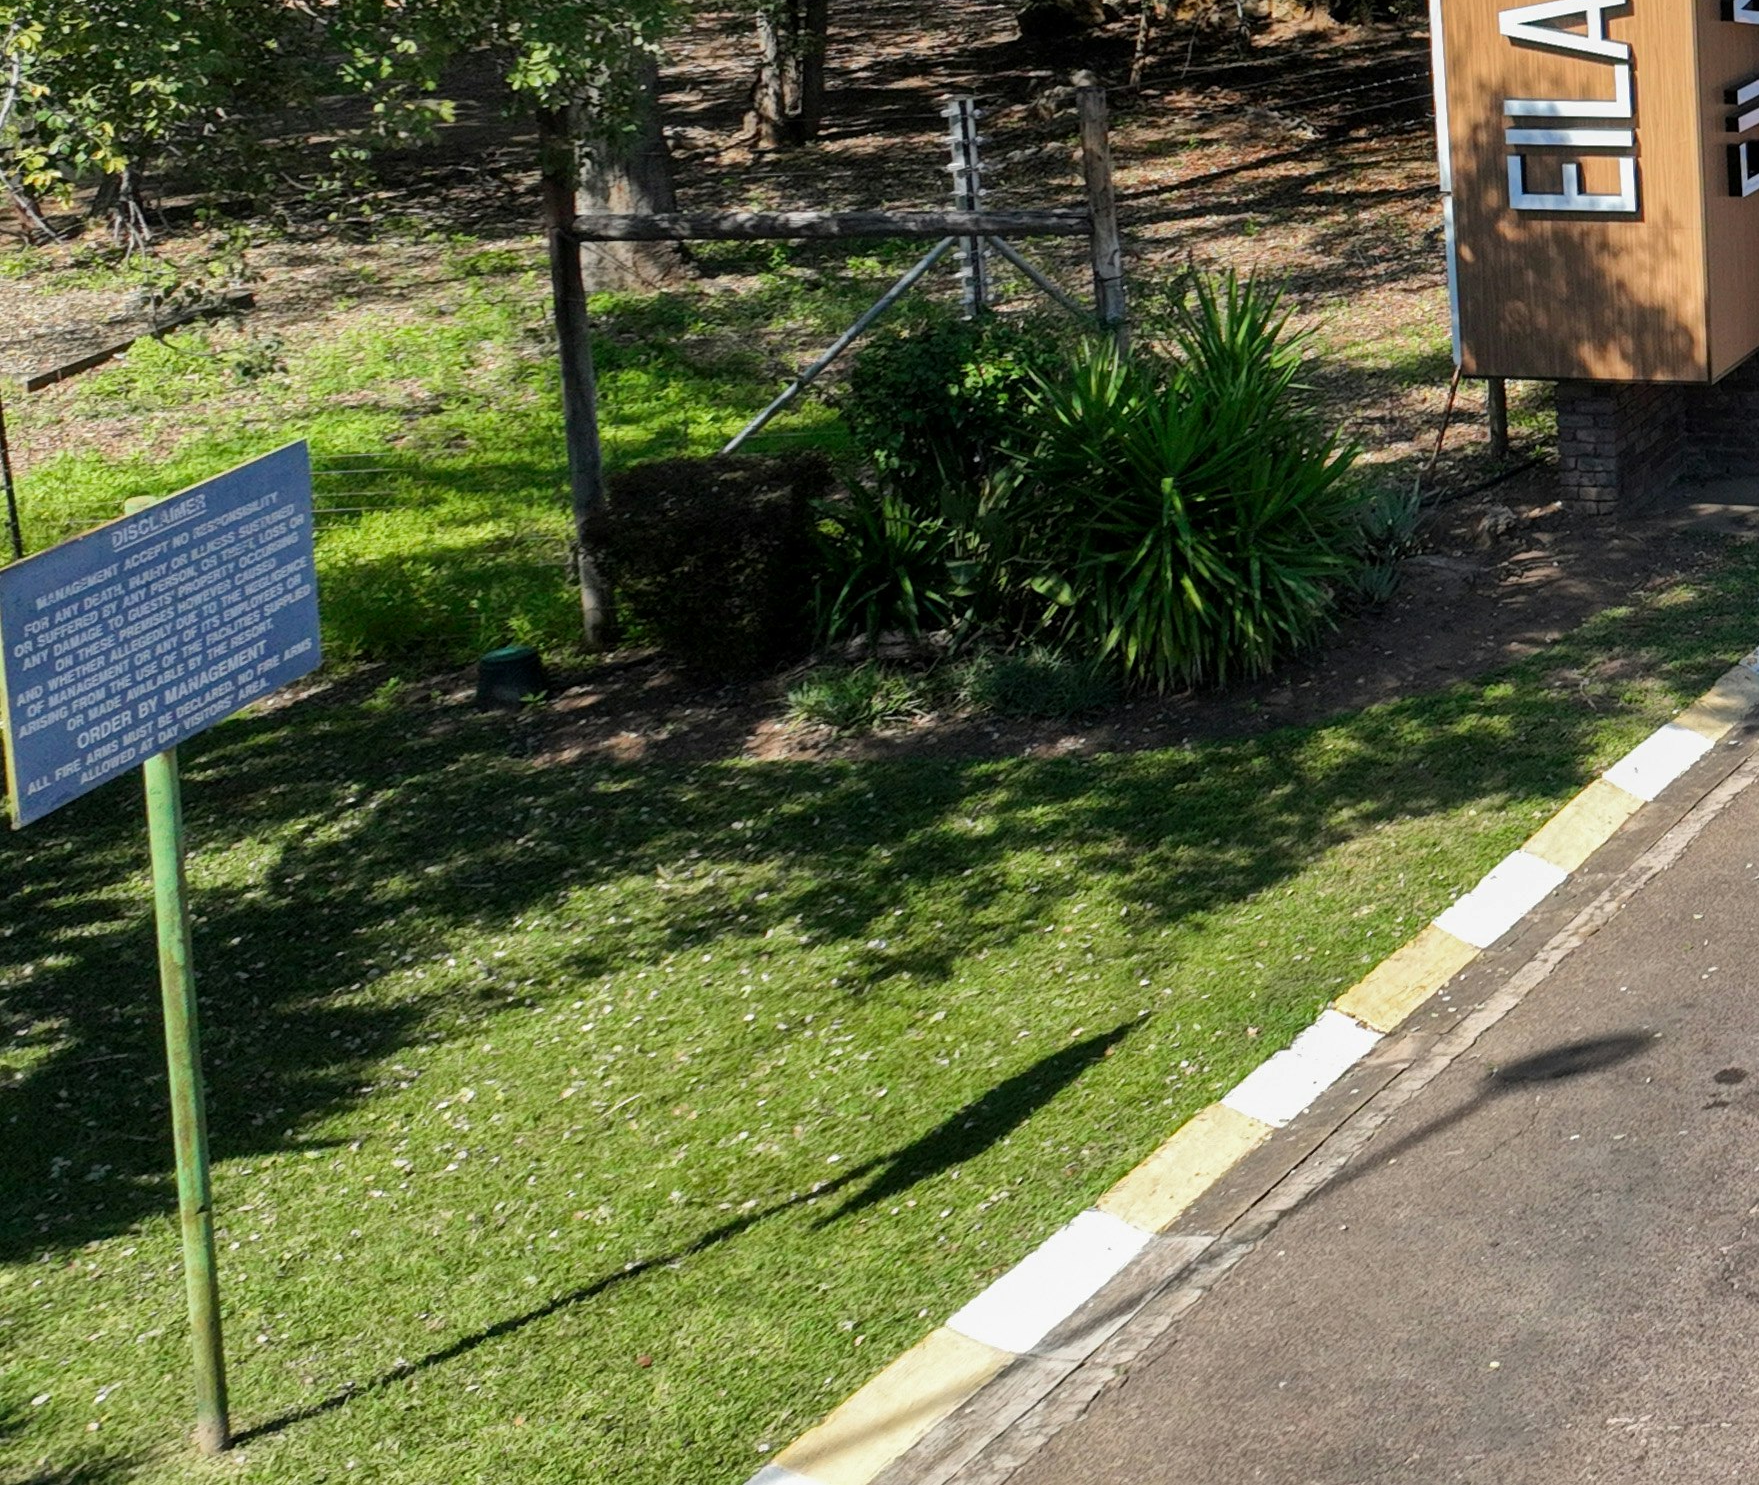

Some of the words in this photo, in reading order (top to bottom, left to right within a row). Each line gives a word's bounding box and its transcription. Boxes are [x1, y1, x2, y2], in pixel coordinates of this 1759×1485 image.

[13, 640, 32, 658] OR
[36, 610, 98, 648] SUFFERED
[101, 601, 117, 618] BY
[122, 587, 146, 608] ANY
[150, 564, 197, 597] PERSON,
[200, 554, 217, 572] OR
[258, 521, 286, 544] LOSS
[289, 513, 304, 529] OR
[23, 616, 49, 637] FOR
[54, 602, 79, 623] ANY
[83, 582, 124, 611] DEATH,
[128, 562, 168, 589] INJURY
[170, 553, 187, 570] OR
[191, 531, 234, 560] ILLNESS
[238, 503, 294, 538] SUSTAINED
[35, 563, 119, 610] MANAGEMENT
[123, 541, 168, 571] ACCEPT
[172, 532, 189, 548] NO
[192, 492, 278, 539] RESPONSIBILITY
[111, 493, 206, 548] DISCLAIMER
[16, 684, 43, 707] AND
[47, 655, 104, 691] WHETHER
[109, 623, 172, 662] ALLEGEDLY
[176, 610, 198, 630] DUE
[202, 601, 216, 617] TO
[220, 589, 241, 607] THE
[244, 556, 307, 595] NEGLIGENCE
[18, 705, 67, 739] ARISING
[71, 687, 105, 712] FROM
[109, 674, 131, 694] THE
[135, 661, 157, 681] USE
[161, 651, 177, 668] OF
[181, 639, 202, 658] THE
[205, 610, 260, 645] FACILITIES
[263, 583, 310, 616] SUPPLIED
[22, 649, 48, 671] ANY
[53, 624, 103, 656] DAMAGE
[108, 614, 123, 631] TO
[177, 562, 234, 597] PROPERTY
[238, 531, 298, 568] OCCURRING
[26, 700, 44, 718] OF
[48, 659, 129, 707] MANAGEMENT
[133, 649, 150, 666] OR
[154, 636, 178, 655] ANY
[182, 626, 197, 642] OF
[201, 615, 219, 632] ITS
[223, 583, 283, 622] EMPLOYEES
[286, 573, 301, 589] OR
[55, 654, 73, 672] ON
[76, 634, 115, 662] THESE
[118, 606, 174, 641] PREMISES
[177, 578, 231, 613] HOWEVER
[234, 557, 275, 586] CAUSED
[27, 774, 50, 795] ALL
[54, 758, 81, 781] FIRE
[85, 739, 118, 765] ARMS
[122, 721, 153, 746] MUST
[157, 711, 173, 728] BE
[237, 668, 253, 685] NO
[257, 654, 280, 675] FIRE
[283, 637, 312, 660] ARMS
[66, 713, 84, 731] OR
[88, 695, 121, 721] MADE
[125, 663, 184, 701] AVAILABLE
[188, 654, 202, 670] BY
[206, 641, 227, 660] THE
[77, 710, 132, 749] ORDER
[137, 696, 158, 718] BY
[164, 639, 267, 705] MANAGEMENT
[80, 746, 135, 784] ALLOWED
[139, 737, 153, 753] AT
[157, 724, 180, 744] DAY
[237, 675, 269, 701] AREA.
